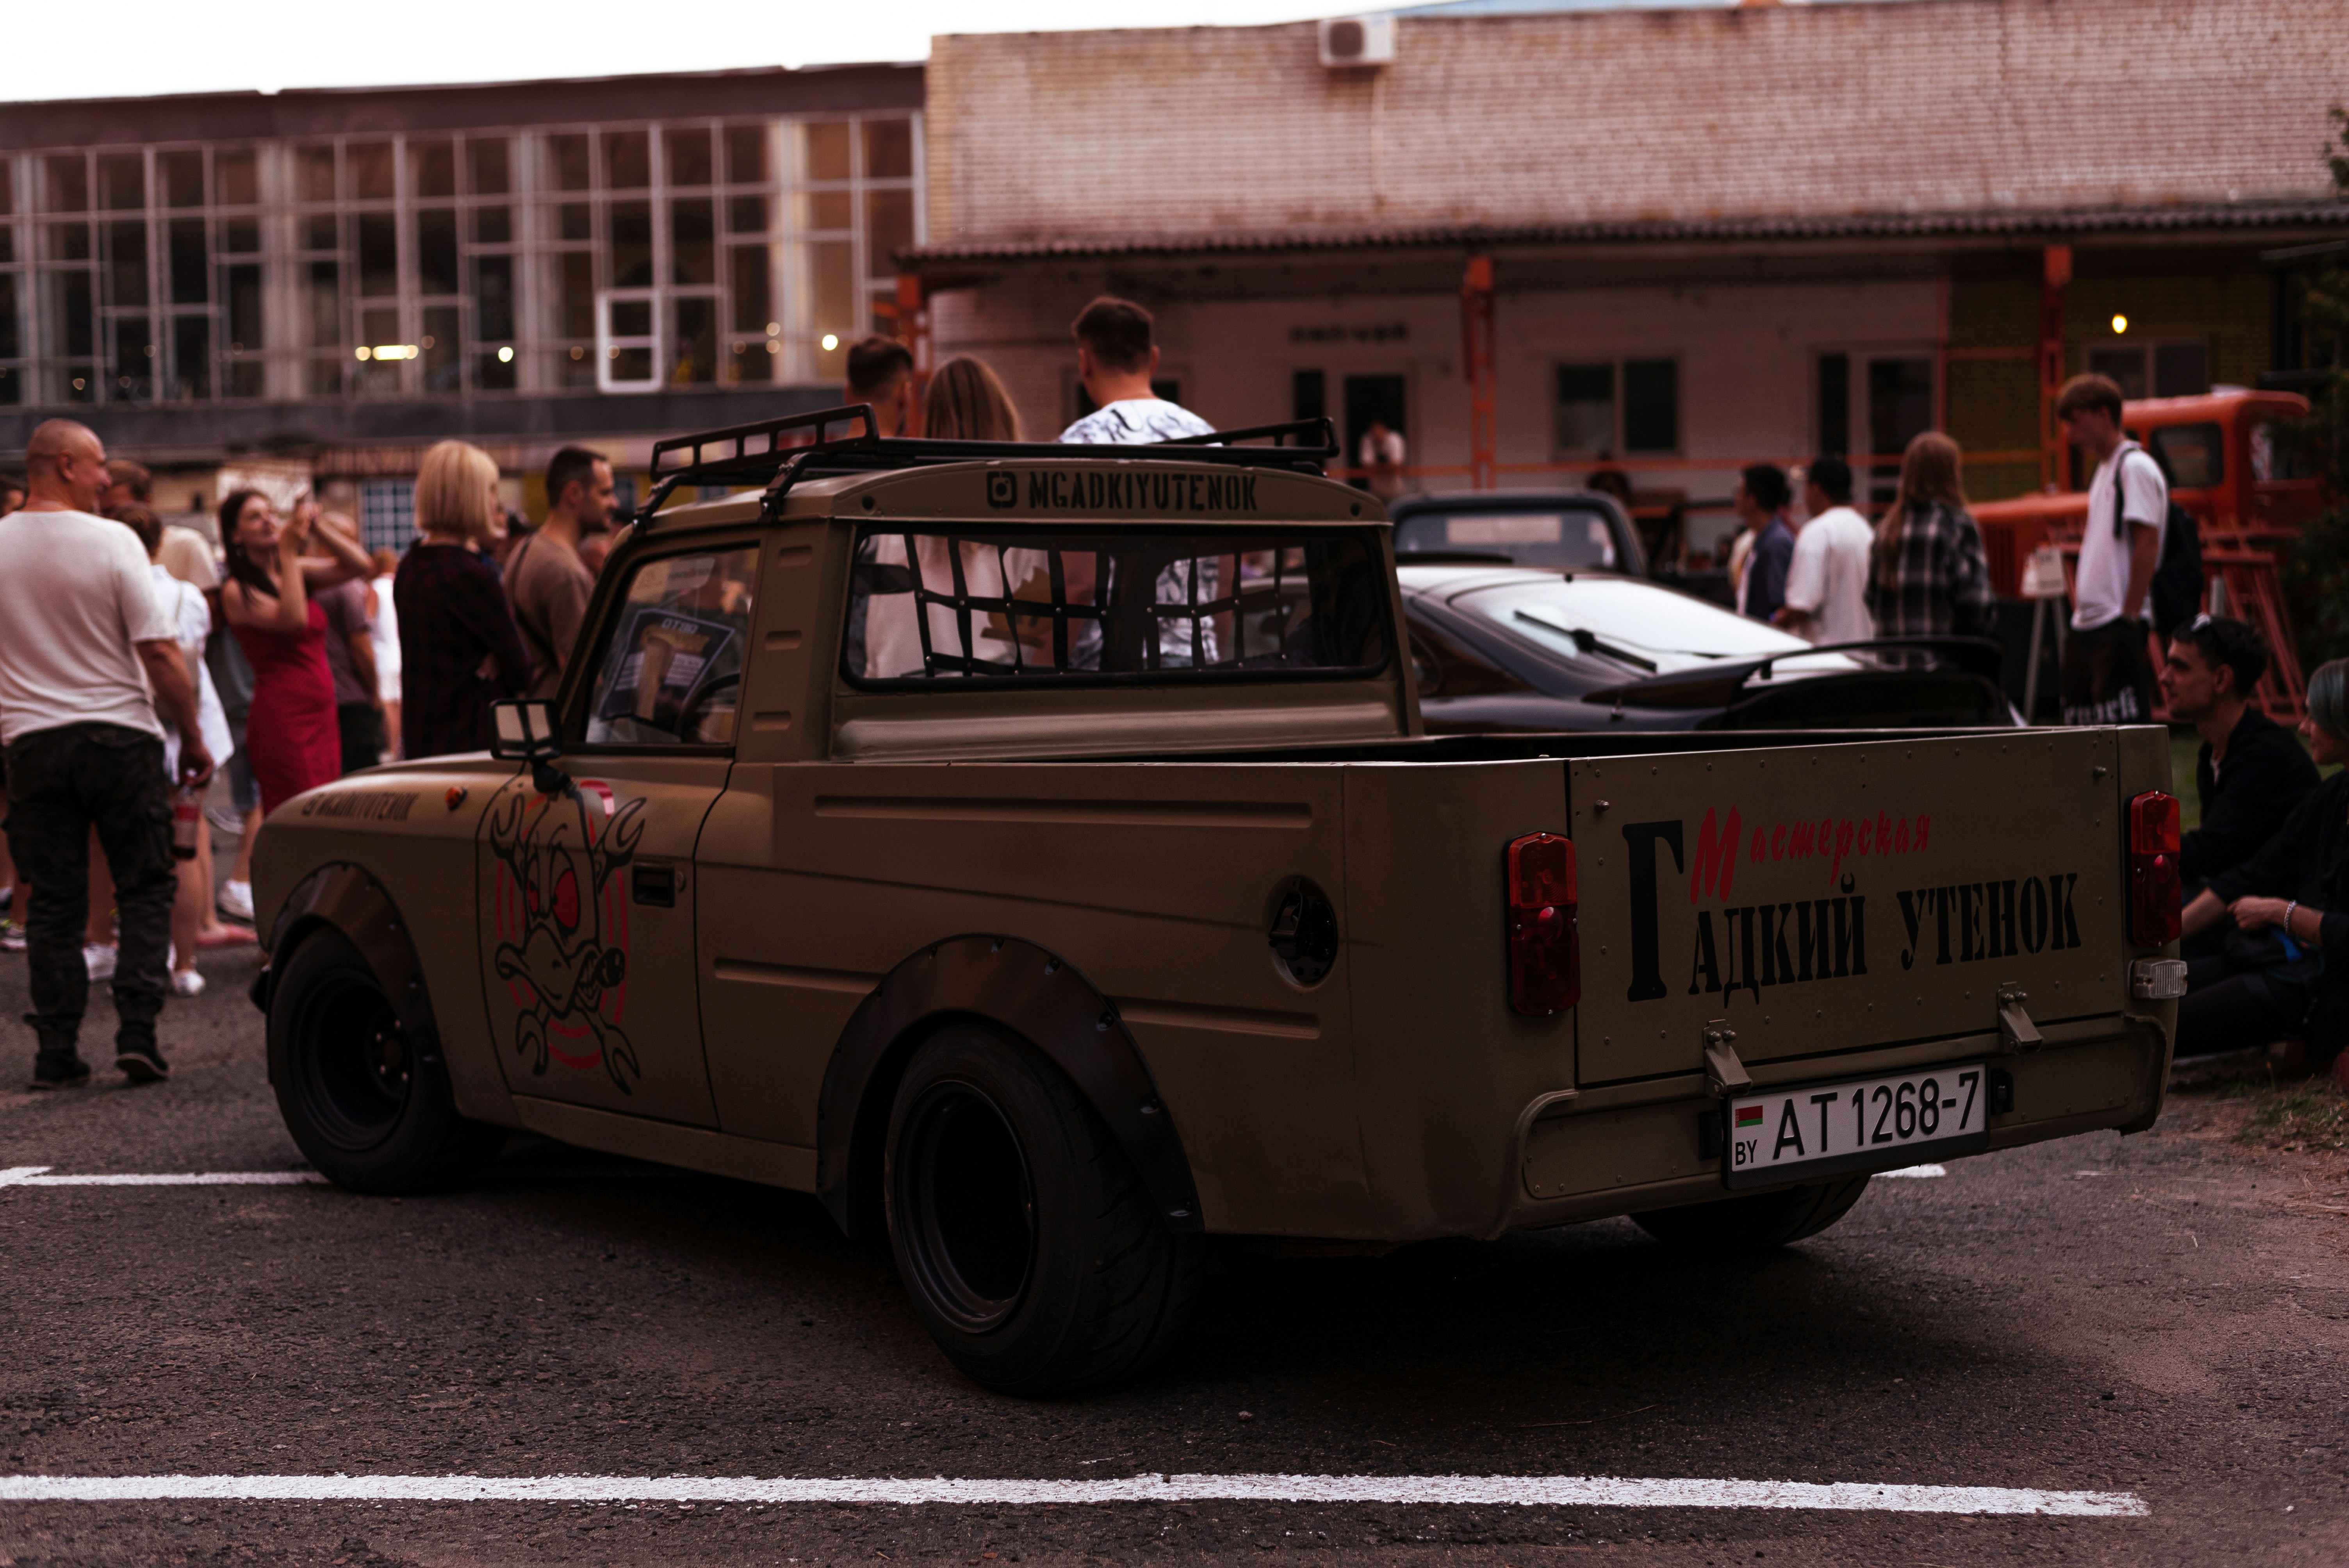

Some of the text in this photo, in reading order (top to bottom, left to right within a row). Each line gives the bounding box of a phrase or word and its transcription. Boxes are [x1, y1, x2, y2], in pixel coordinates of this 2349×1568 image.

[1028, 470, 1258, 511] MGADKIYUTENOK
[1690, 805, 1930, 905] Мастерская
[1622, 820, 2081, 1009] ГАДКИЙ УТЕНОК
[1736, 1139, 1757, 1166] BY
[1773, 1071, 1979, 1160] AT 1268-7
